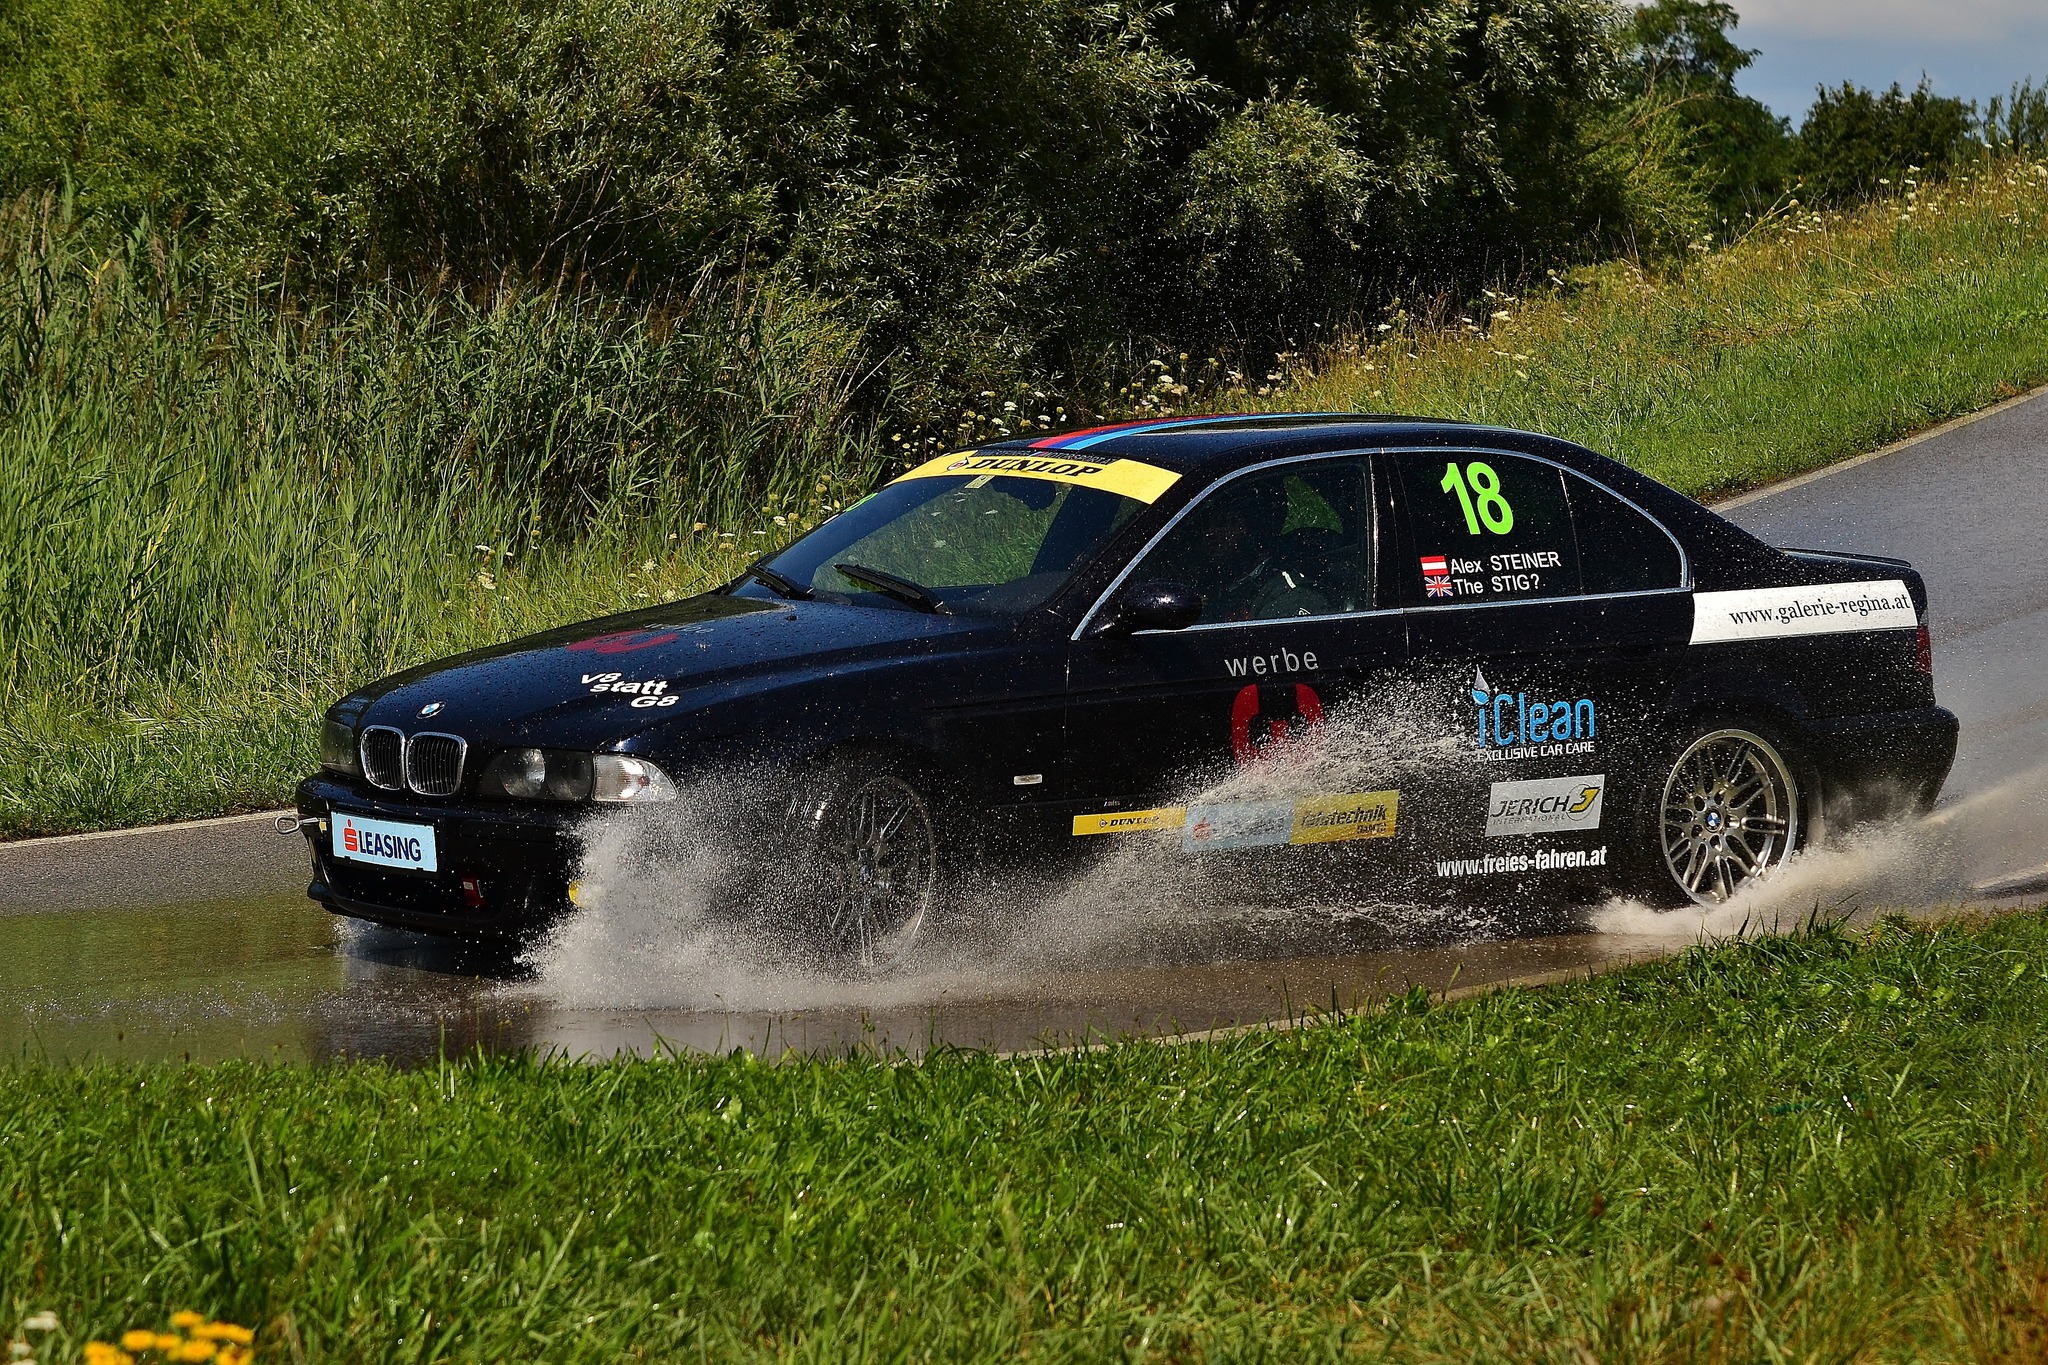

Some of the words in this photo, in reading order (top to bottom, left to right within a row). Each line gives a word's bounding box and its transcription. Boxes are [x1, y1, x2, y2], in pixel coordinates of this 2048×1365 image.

[965, 459, 1103, 477] DUNLOP
[1441, 462, 1513, 535] 18
[1451, 558, 1483, 574] Alex
[1490, 551, 1561, 571] STEINER
[1453, 578, 1484, 595] The
[1492, 573, 1539, 592] STIG?
[1729, 594, 1911, 624] www.galerie-regina.at
[1224, 647, 1318, 677] werbe
[581, 672, 622, 684] V8
[590, 679, 668, 695] statt
[630, 695, 680, 708] G8
[1472, 688, 1595, 748] iClean
[1474, 746, 1538, 762] EXCLUSIVE
[1540, 743, 1563, 757] CAR
[1565, 741, 1595, 755] CARE
[1490, 795, 1571, 818] JERICH
[358, 830, 422, 862] LEASING
[1436, 845, 1607, 876] www.freies-fahren.at
